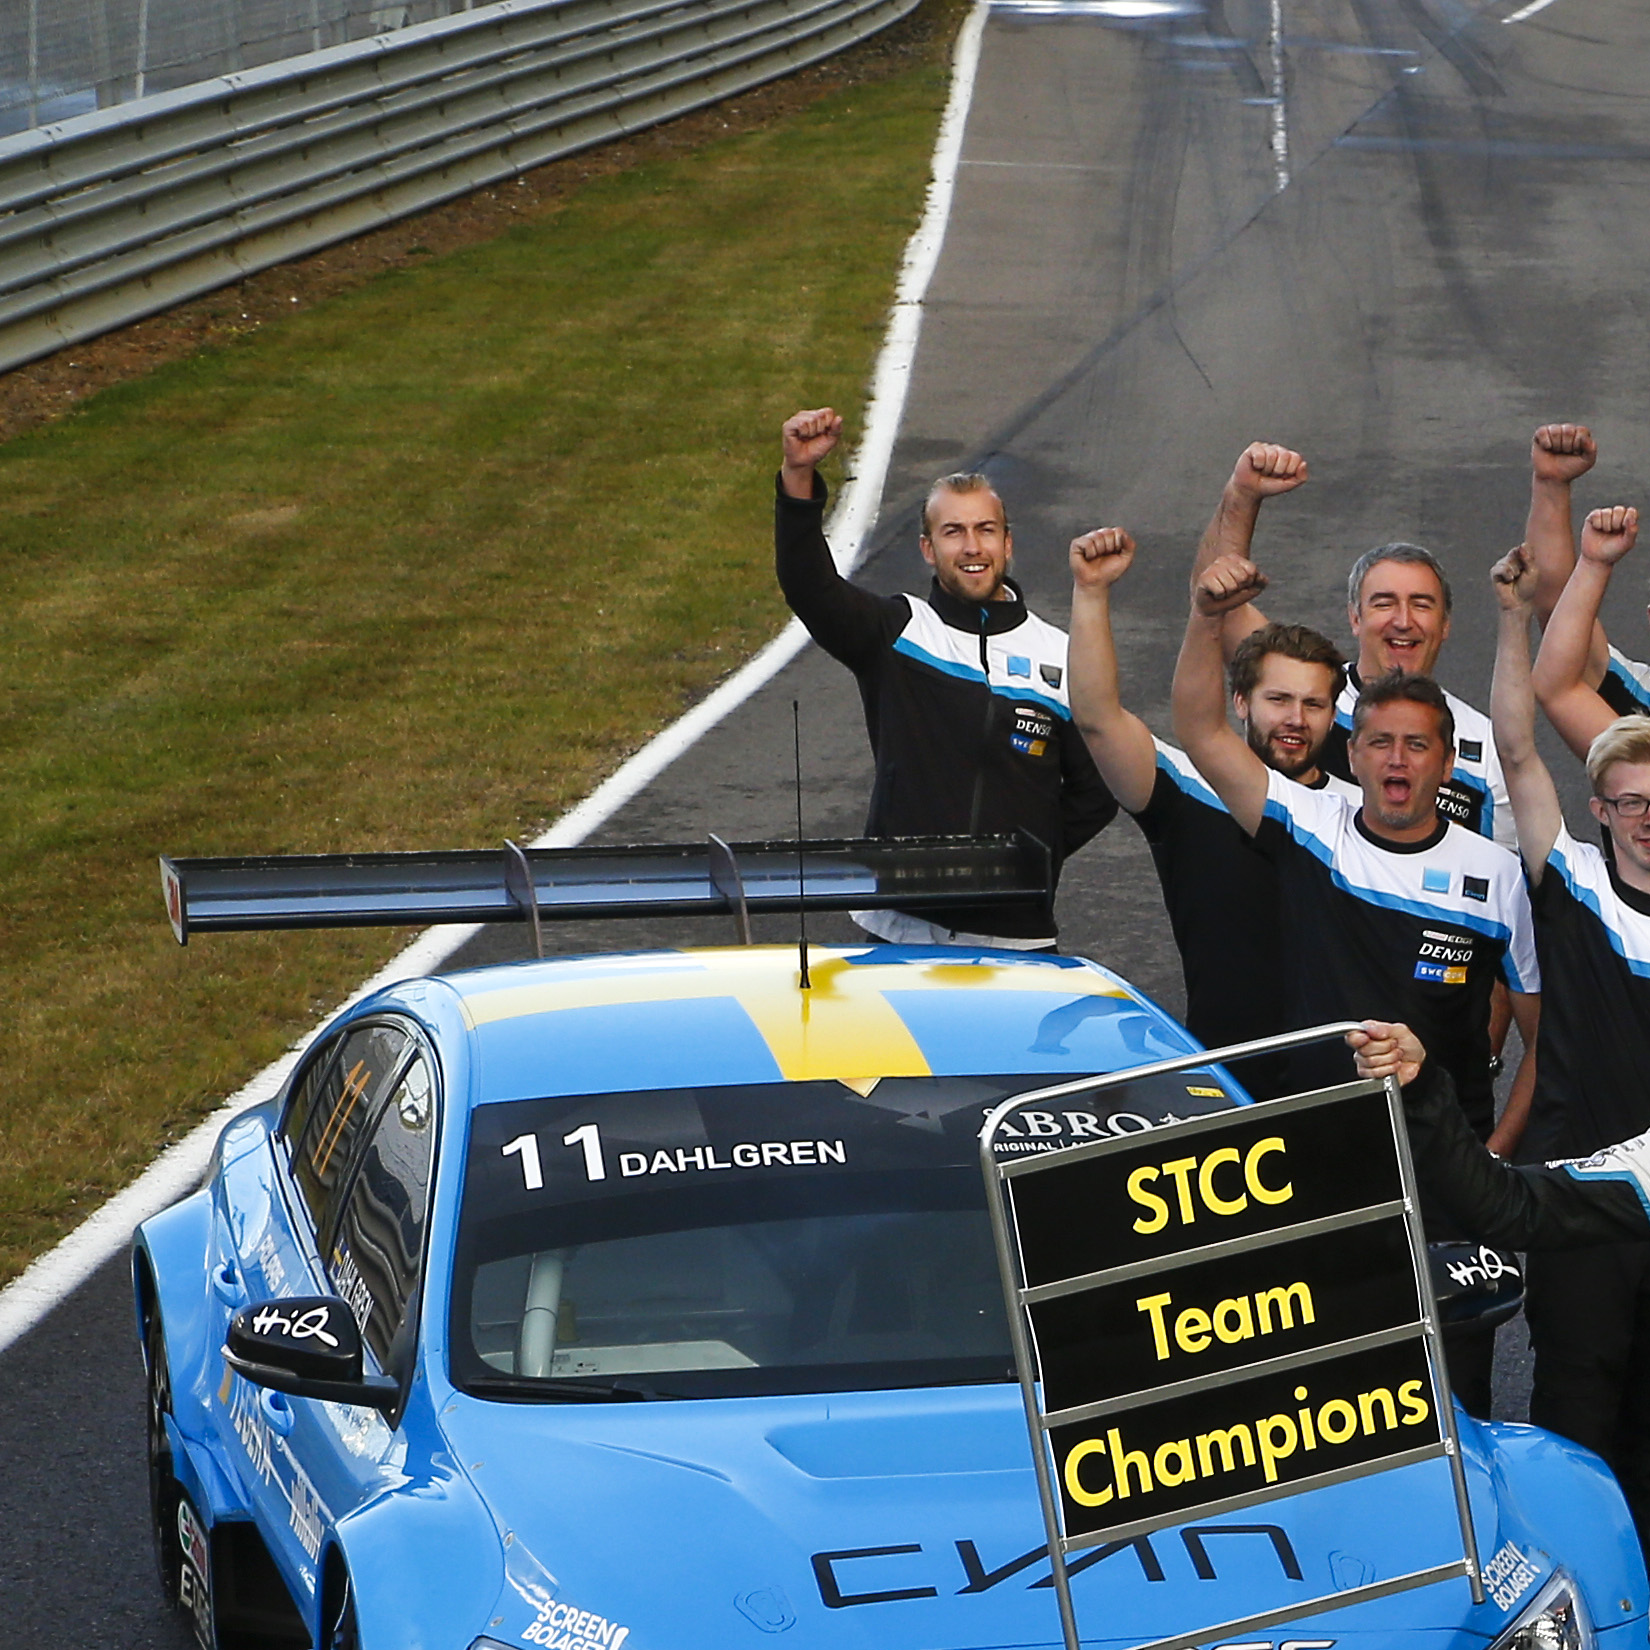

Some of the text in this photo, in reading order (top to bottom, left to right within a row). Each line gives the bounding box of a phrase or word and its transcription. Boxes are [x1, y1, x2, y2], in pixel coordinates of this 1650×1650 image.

[1419, 942, 1473, 962] DENSO
[502, 1124, 847, 1191] 11 DAHLGREN
[985, 1142, 1058, 1152] RIGINAL
[1126, 1136, 1294, 1236] STCC
[252, 1305, 339, 1348] HiQ
[1136, 1280, 1316, 1361] Team
[1064, 1378, 1430, 1508] Champions
[537, 1600, 619, 1646] SCREEN
